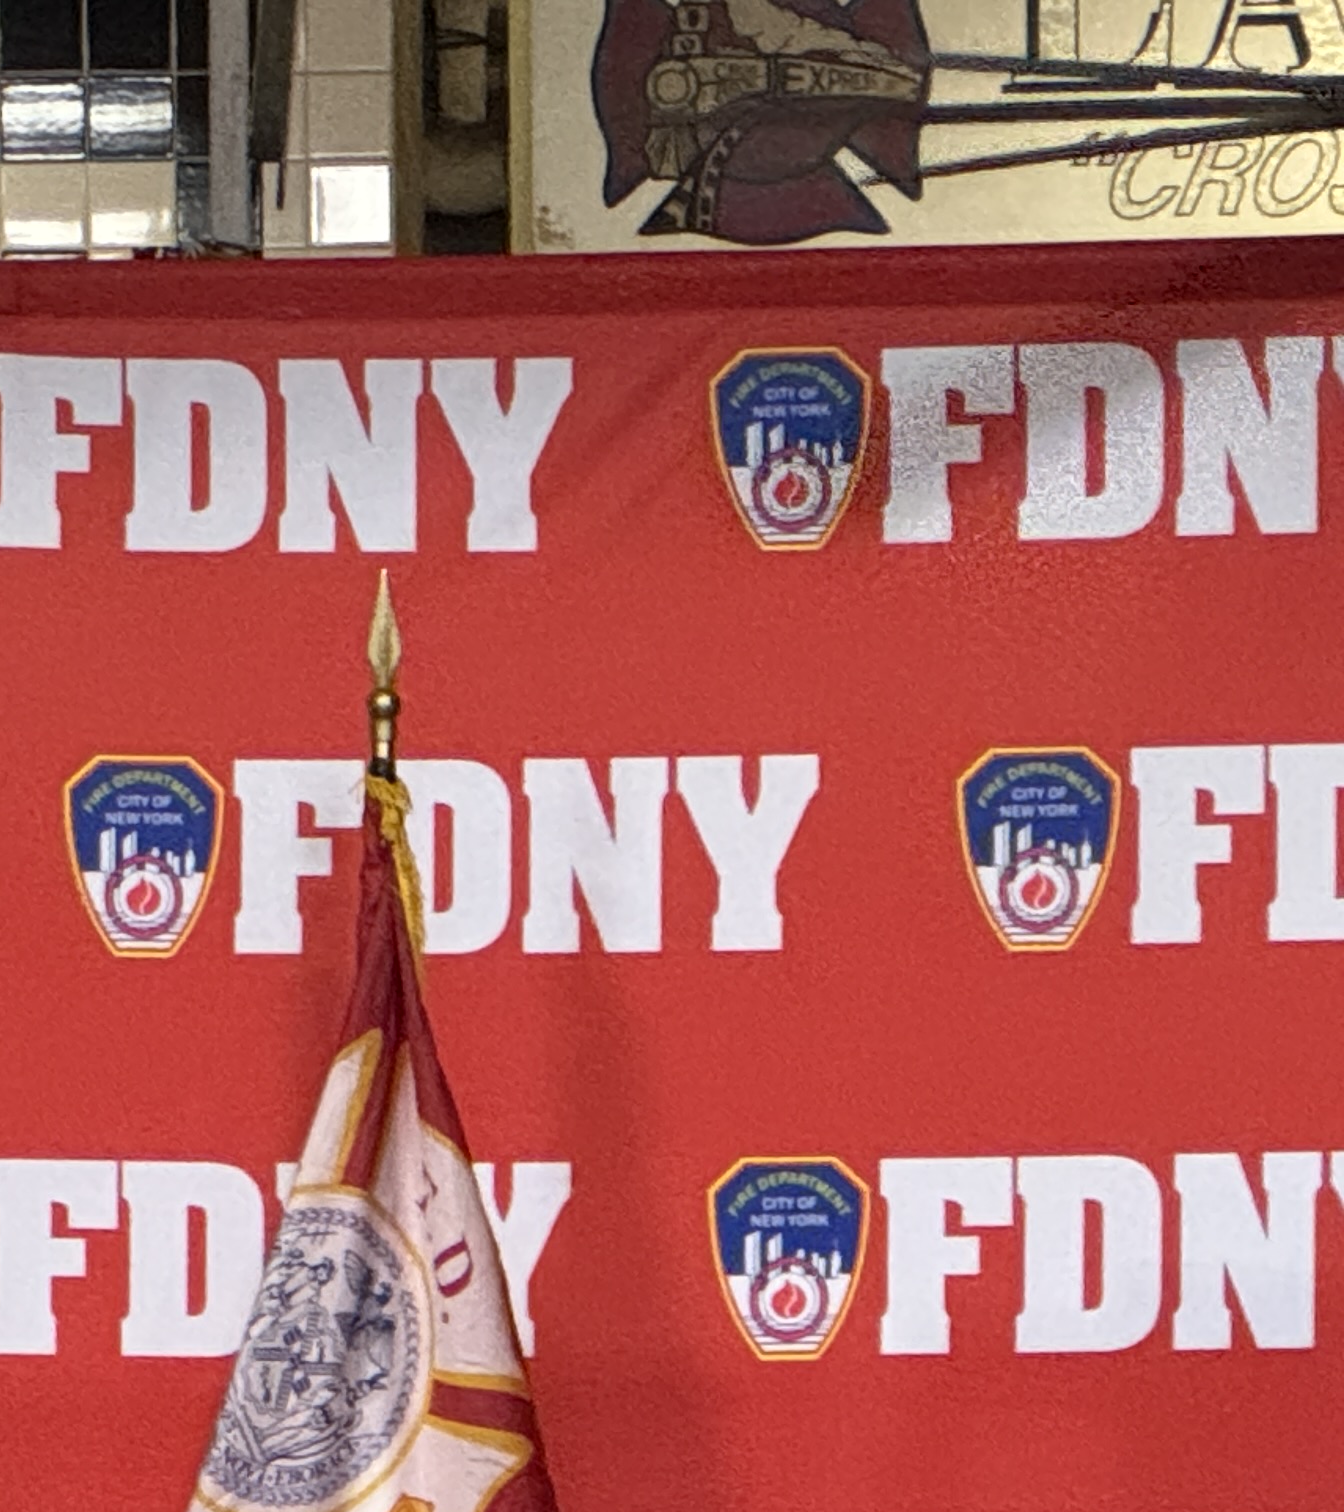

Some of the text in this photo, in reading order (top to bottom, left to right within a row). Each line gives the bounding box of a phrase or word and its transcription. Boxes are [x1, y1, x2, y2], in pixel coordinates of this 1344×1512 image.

[763, 386, 819, 400] CITY OF
[752, 404, 832, 418] NEW YORK
[1011, 787, 1068, 800] CITY OF
[116, 794, 172, 808] CITY OF
[1000, 804, 1079, 818] NEW YORK
[105, 812, 184, 825] NEW YORK
[234, 755, 818, 953] FDNY
[761, 1196, 818, 1210] CITY OF
[749, 1214, 829, 1228] NEW YORK
